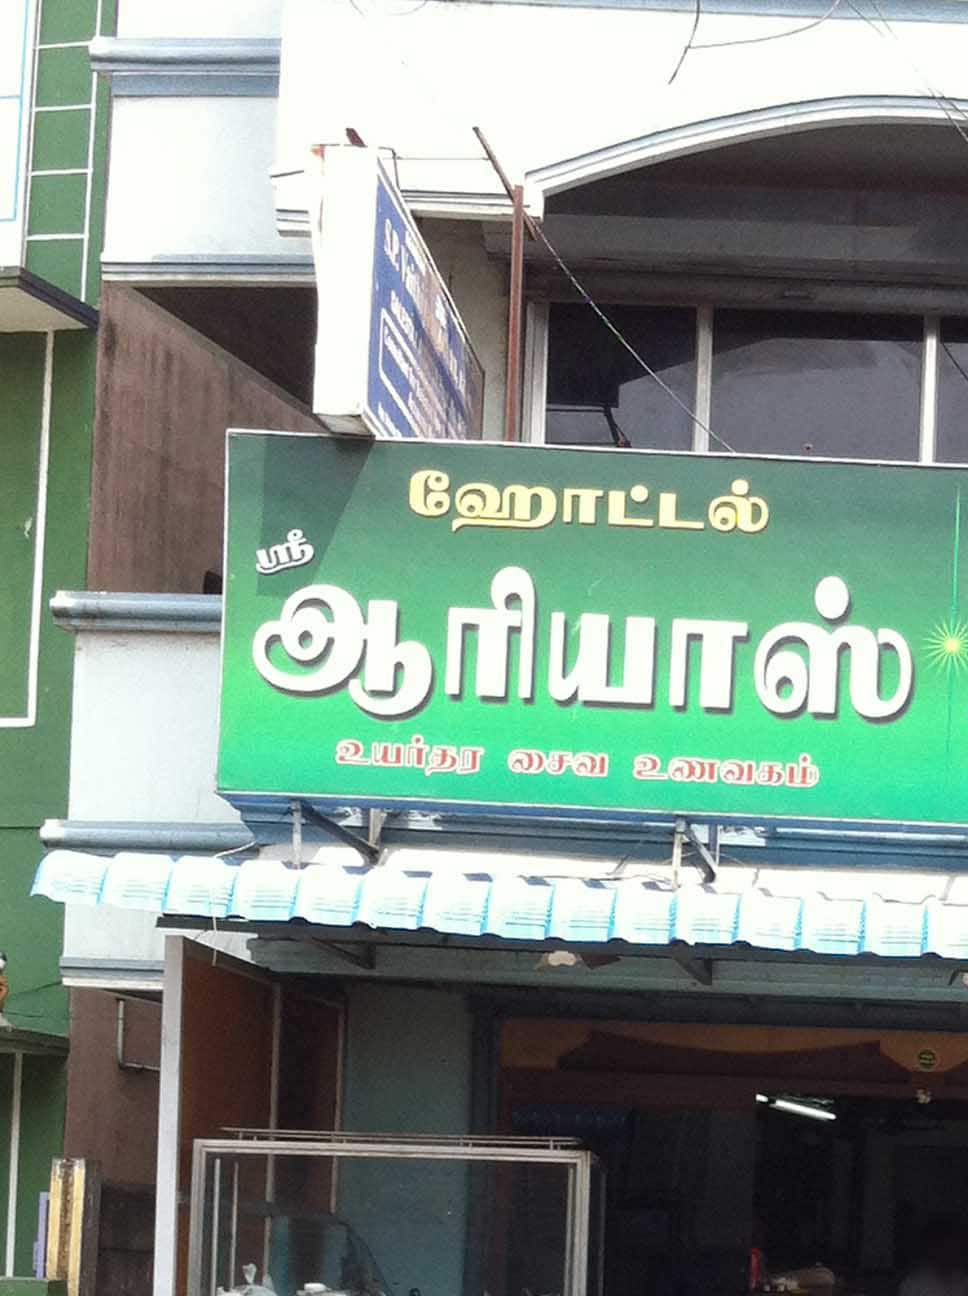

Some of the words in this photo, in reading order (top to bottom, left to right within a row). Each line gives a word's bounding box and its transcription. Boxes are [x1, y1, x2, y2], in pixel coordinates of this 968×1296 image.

[408, 468, 770, 533] ஹோட்டல்
[252, 566, 914, 723] ஆரியாஸ்
[336, 734, 484, 776] உயர்தர
[507, 749, 610, 779] சைவ
[632, 753, 820, 789] உணவகம்
